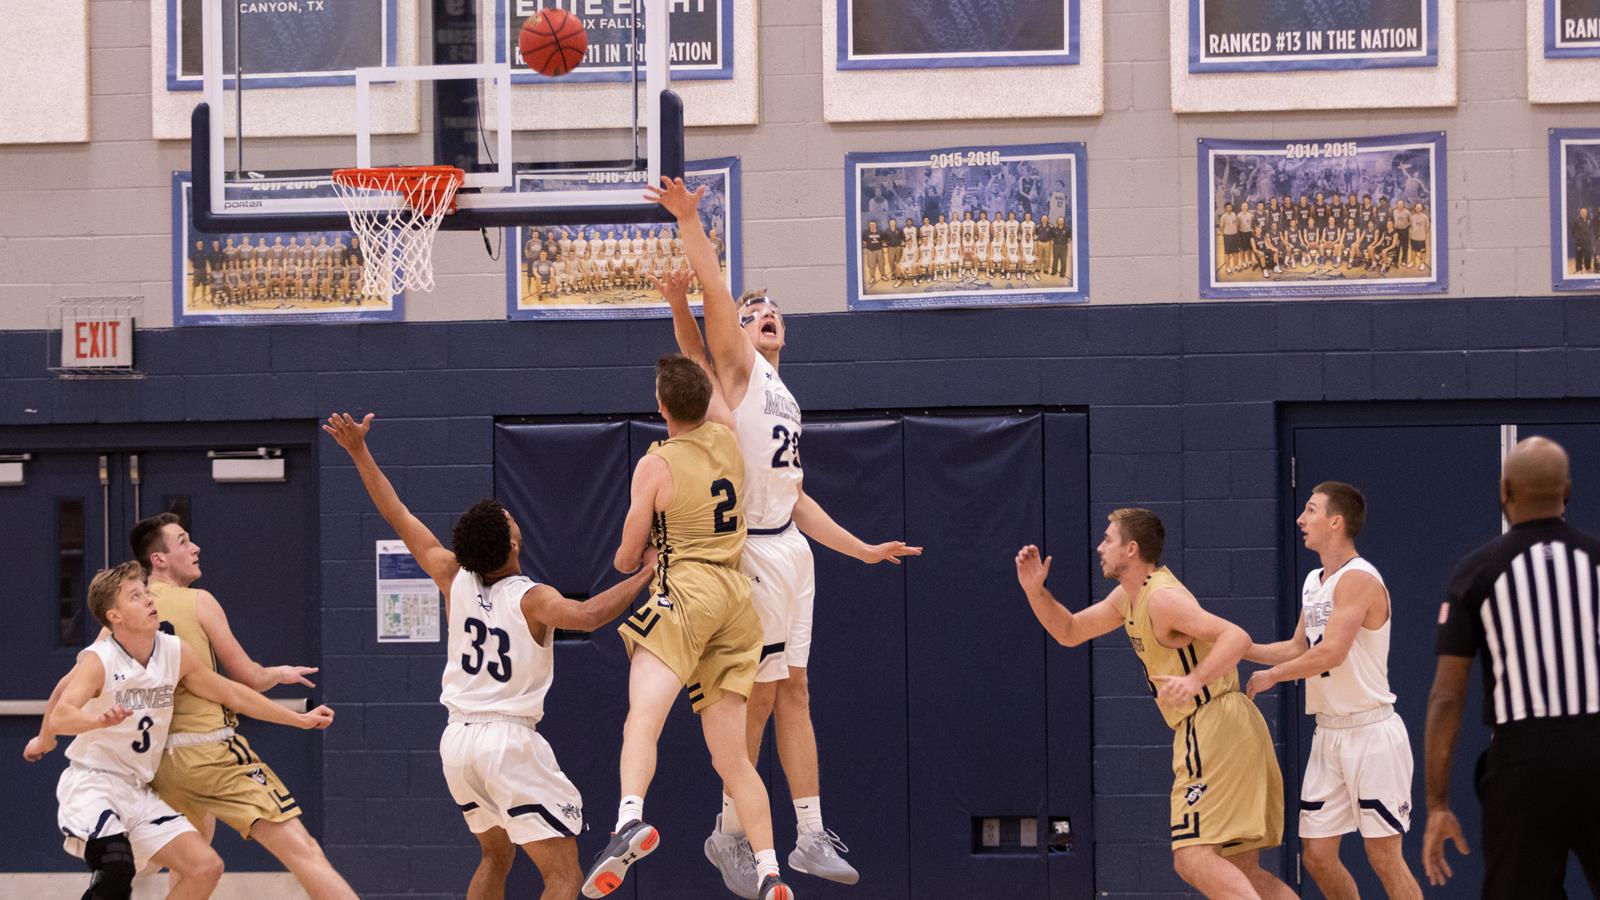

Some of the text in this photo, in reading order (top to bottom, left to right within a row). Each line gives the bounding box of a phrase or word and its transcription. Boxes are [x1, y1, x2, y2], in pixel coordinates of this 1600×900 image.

[240, 1, 324, 13] CANYON, TX
[600, 18, 645, 30] FALLS,
[1565, 18, 1600, 38] RAN
[1209, 27, 1417, 54] RANKED #13 IN THE NATION
[605, 43, 620, 63] IN
[625, 43, 647, 62] TH
[669, 42, 712, 61] ATION
[930, 150, 1000, 168] 2015-2016
[1286, 142, 1357, 159] 2014-2015
[588, 170, 648, 184] 2016-201
[75, 321, 120, 358] EXIT
[710, 477, 738, 533] 2
[461, 617, 512, 683] 33
[116, 685, 174, 710] MINES
[131, 715, 154, 753] 3
